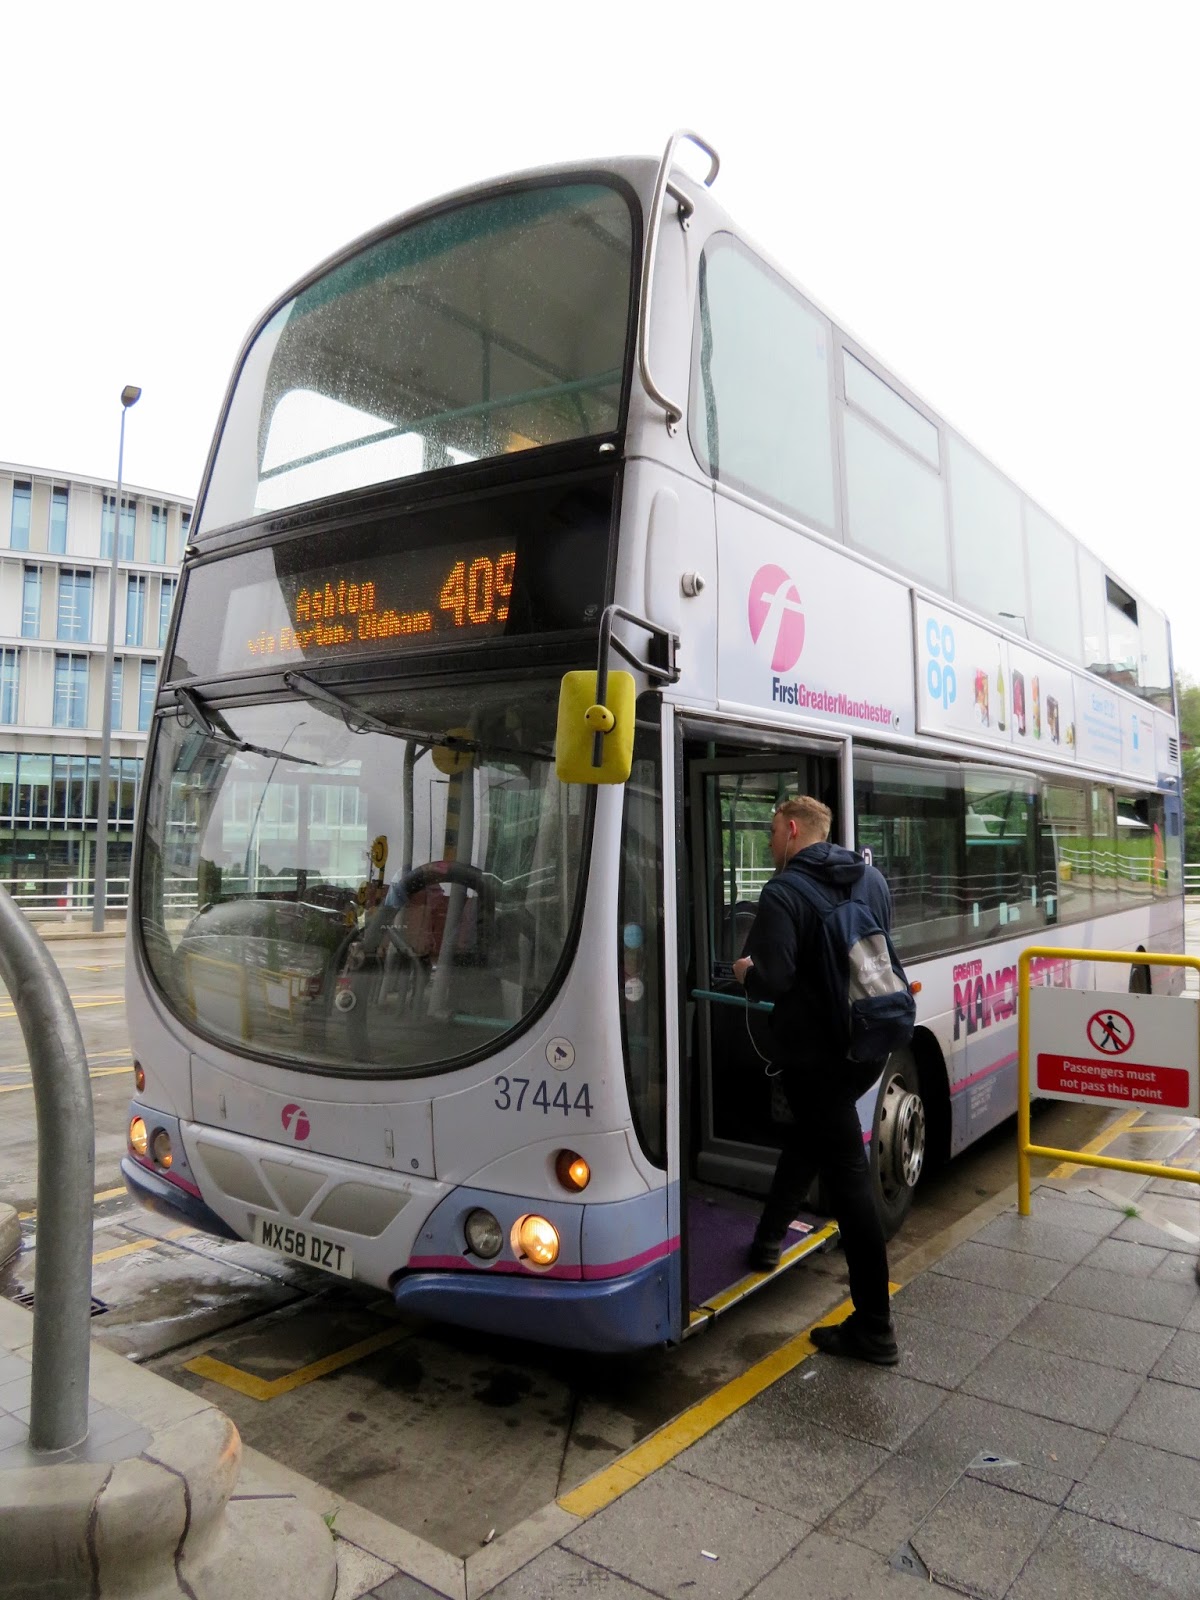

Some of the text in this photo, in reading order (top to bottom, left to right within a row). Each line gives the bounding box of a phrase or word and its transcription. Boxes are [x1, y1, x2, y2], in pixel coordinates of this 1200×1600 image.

[296, 580, 375, 622] Ashton
[248, 631, 275, 655] via
[358, 610, 432, 640] Oldham
[953, 958, 982, 982] GREATER
[1060, 1078, 1163, 1099] not pass this point
[1063, 1061, 1157, 1082] Passengers must
[493, 1075, 594, 1117] 37444
[262, 1221, 346, 1272] MX58 DZT
